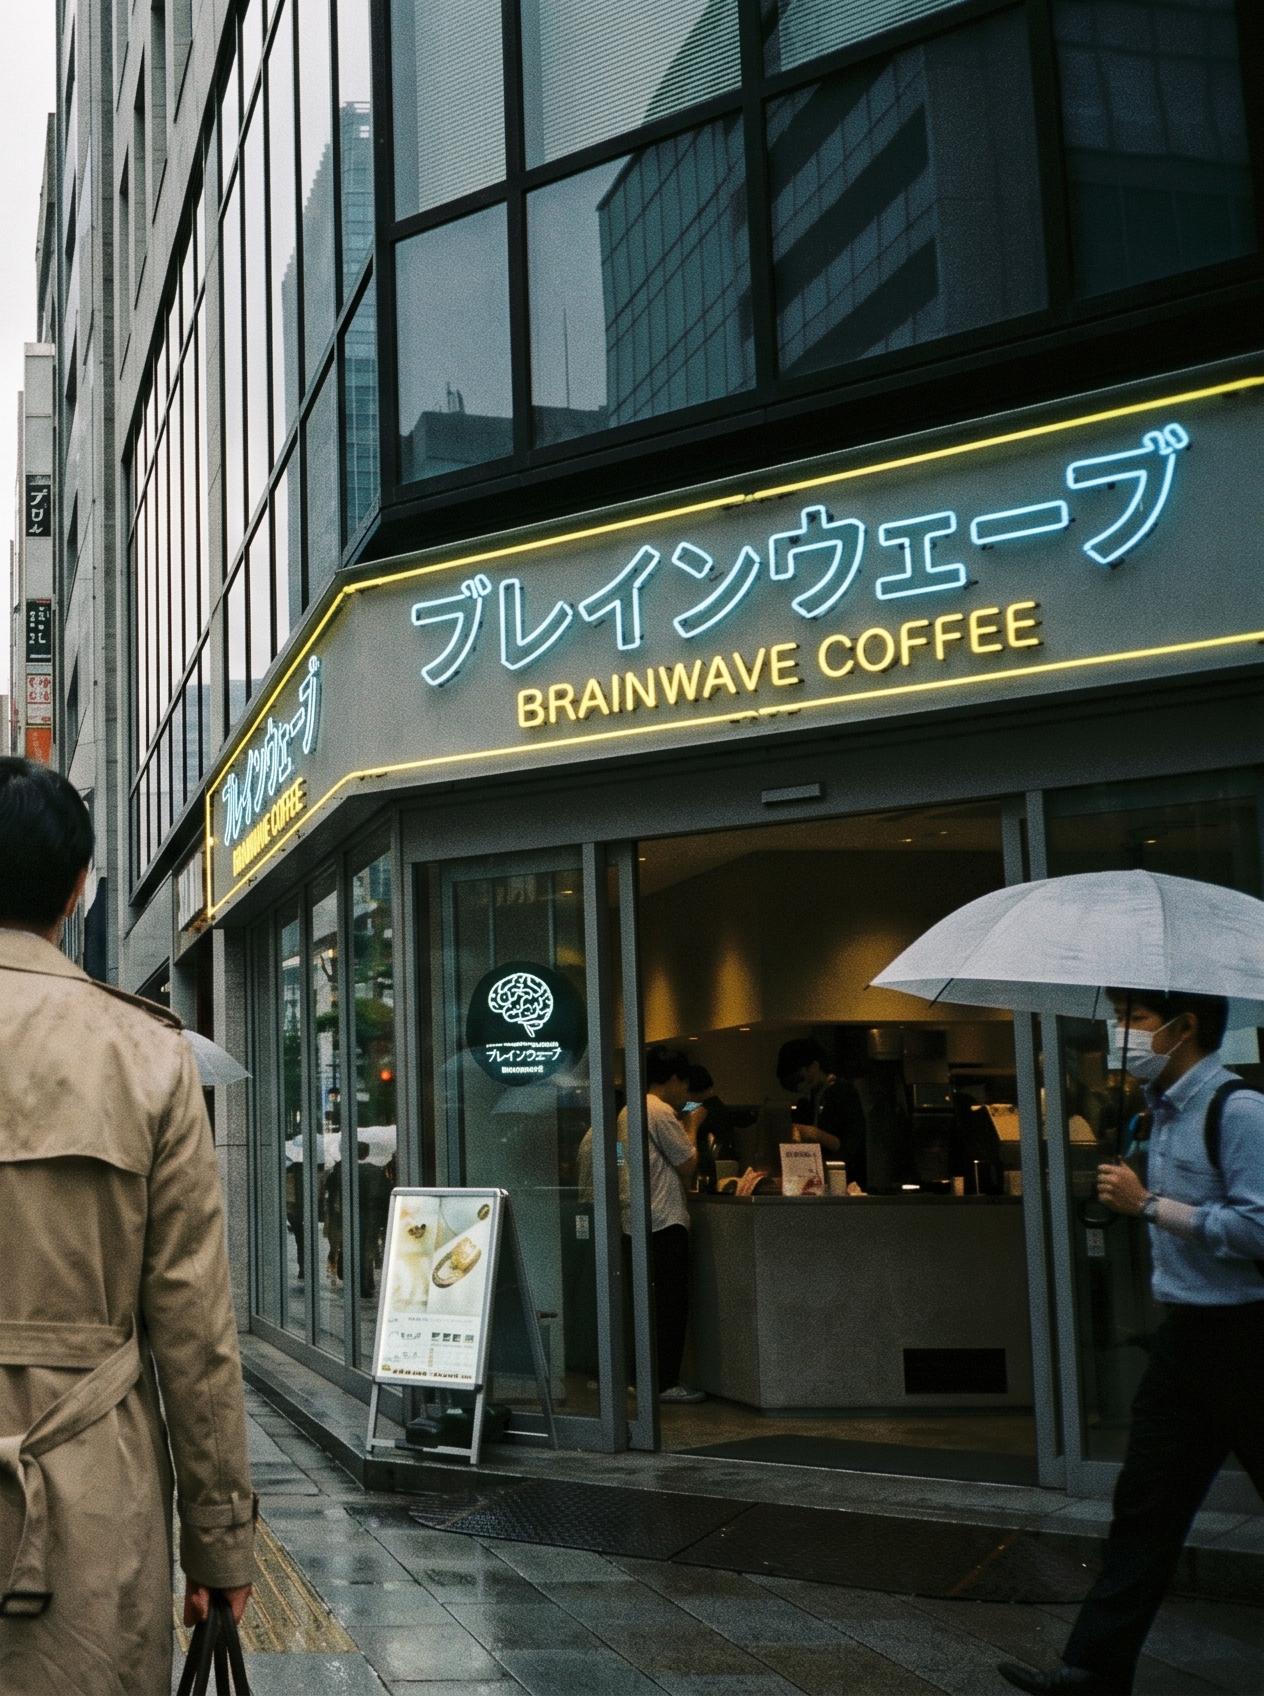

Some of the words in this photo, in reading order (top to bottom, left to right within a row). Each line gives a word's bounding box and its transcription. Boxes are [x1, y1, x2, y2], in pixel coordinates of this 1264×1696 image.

[411, 422, 1189, 686] ブレインウェーブ
[516, 642, 799, 729] BRAINWAVE
[817, 601, 1039, 678] COFFEE
